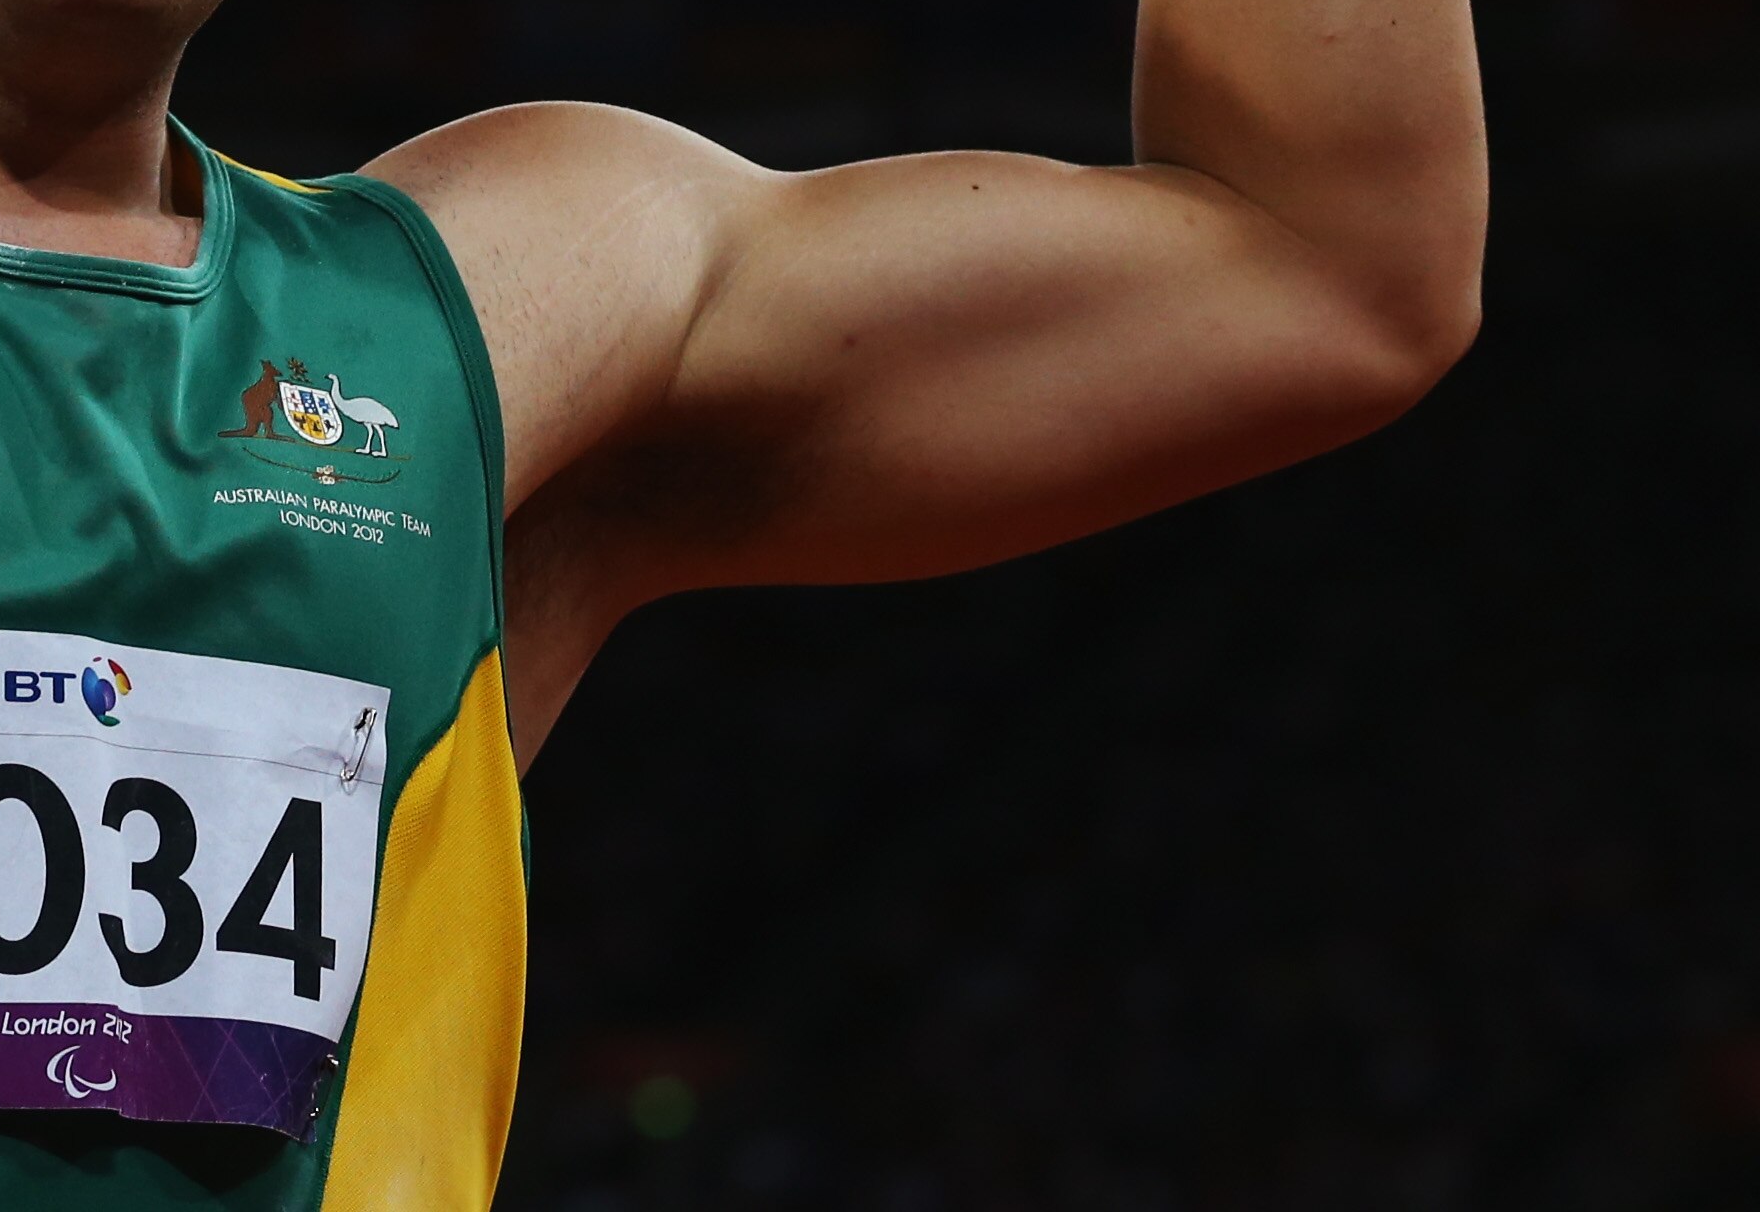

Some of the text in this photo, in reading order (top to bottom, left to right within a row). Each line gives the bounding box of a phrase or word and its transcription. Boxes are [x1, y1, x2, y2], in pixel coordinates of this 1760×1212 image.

[213, 487, 432, 538] AUSTRALIAN PARALYMPIC TEAM
[278, 508, 385, 545] LONDON 2012
[3, 669, 78, 705] BT
[0, 1009, 97, 1036] London
